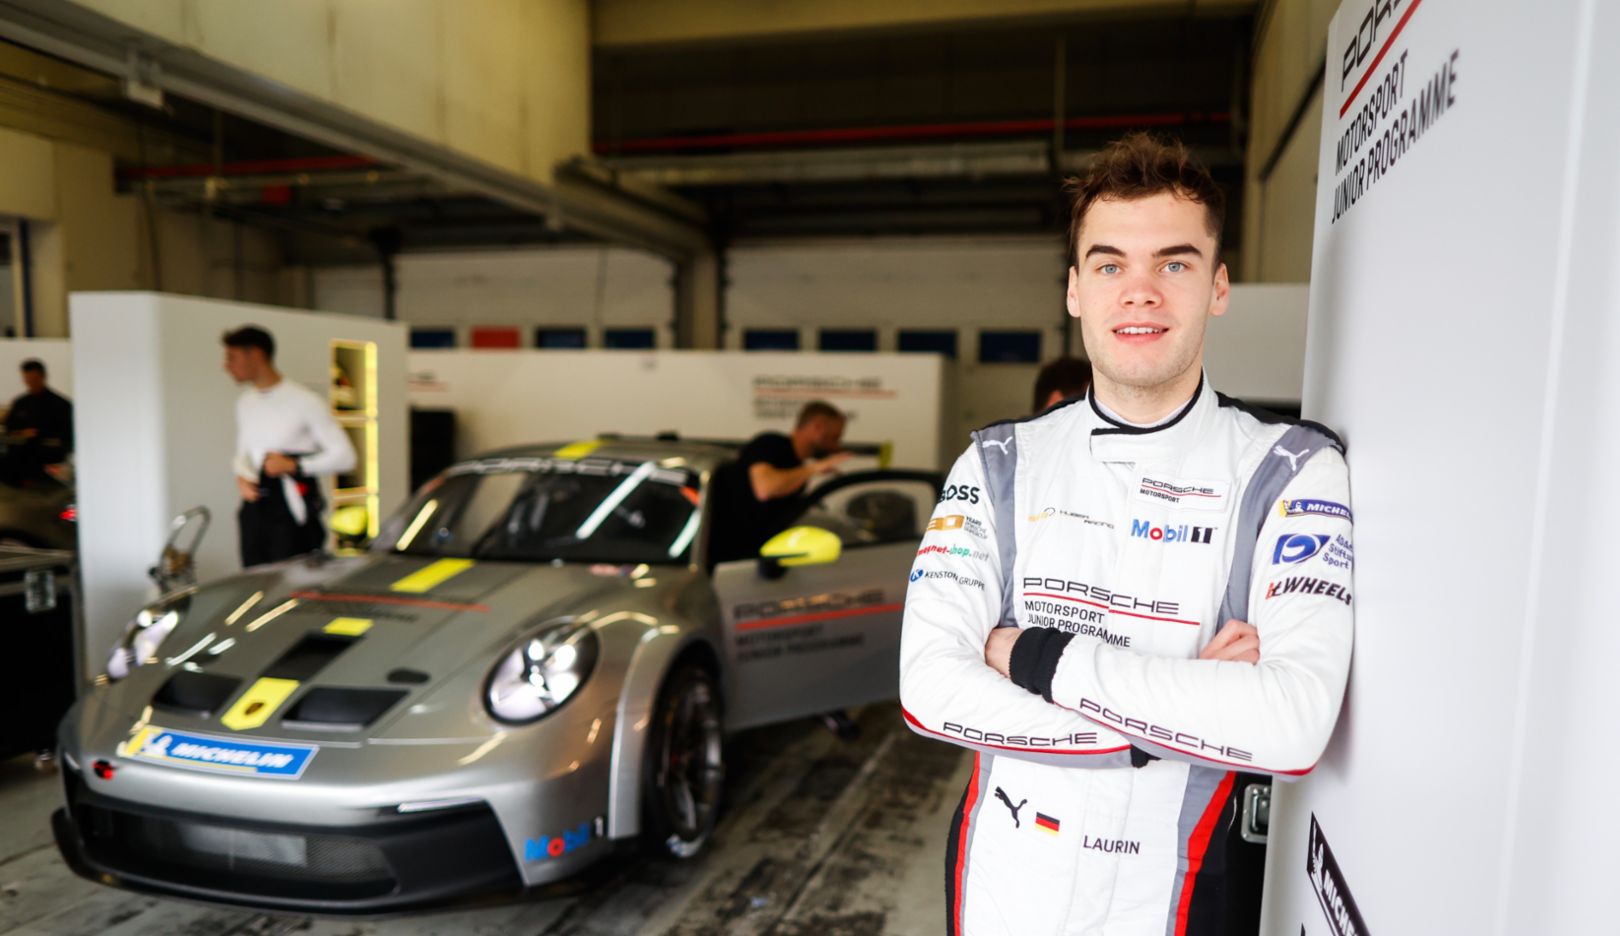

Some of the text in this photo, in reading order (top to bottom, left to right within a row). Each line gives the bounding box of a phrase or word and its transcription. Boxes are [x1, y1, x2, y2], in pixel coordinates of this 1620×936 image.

[1335, 48, 1408, 176] MOTORSPORT
[1332, 48, 1459, 224] JUNIOR PROGRAMME
[1140, 489, 1180, 503] MOTORSPORT
[1142, 477, 1214, 495] PORSCHE
[1131, 519, 1187, 543] Mobil
[1322, 552, 1349, 569] Sport
[924, 570, 986, 591] KENSTON GRUPPE
[1023, 577, 1179, 615] PORSCHE
[1024, 600, 1105, 624] MOTORSPORT
[1027, 613, 1131, 648] JUNIOR PROGRAMME
[943, 721, 1097, 746] PORSCHE
[1080, 698, 1253, 761] PORSCHE
[171, 742, 294, 769] MICHELIN
[524, 823, 589, 864] Mobil
[1083, 835, 1140, 855] LAURIN
